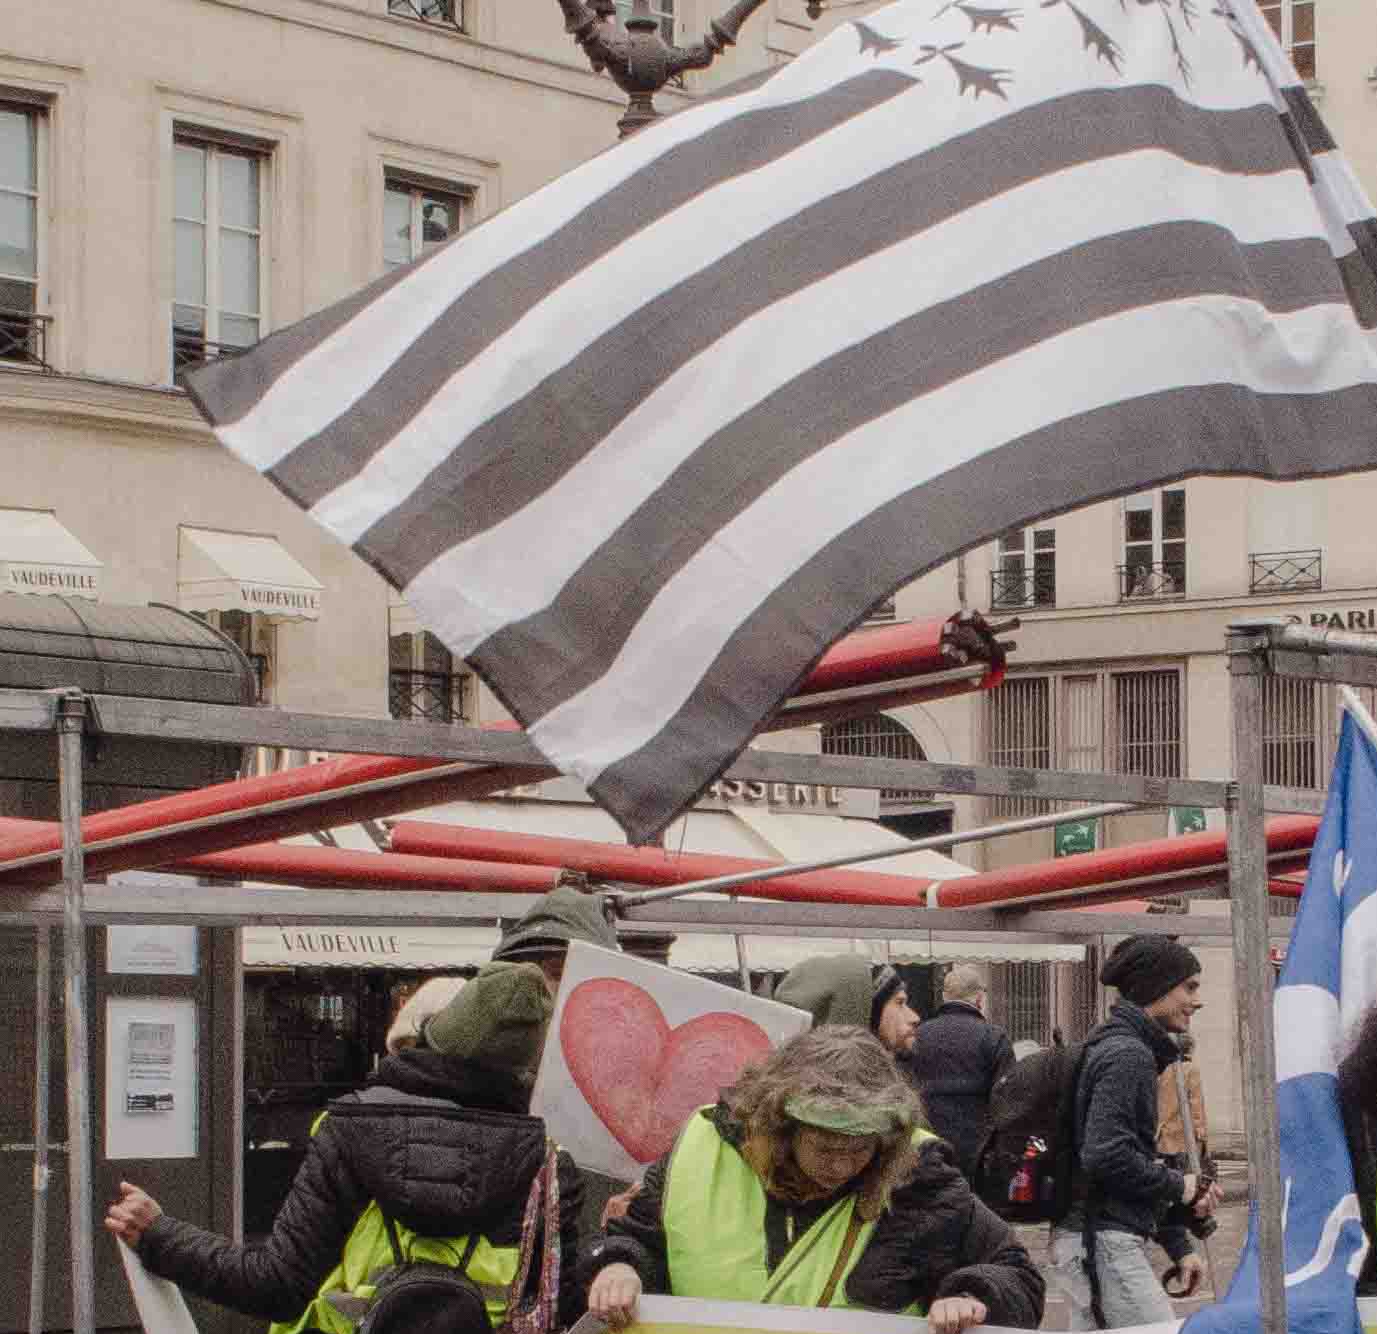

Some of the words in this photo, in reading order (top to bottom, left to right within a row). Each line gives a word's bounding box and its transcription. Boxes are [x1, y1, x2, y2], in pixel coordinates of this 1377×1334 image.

[9, 568, 97, 590] VAUDEVILLE
[240, 587, 319, 610] VAUDEVILLE
[281, 933, 401, 953] VAUDEVILLE
